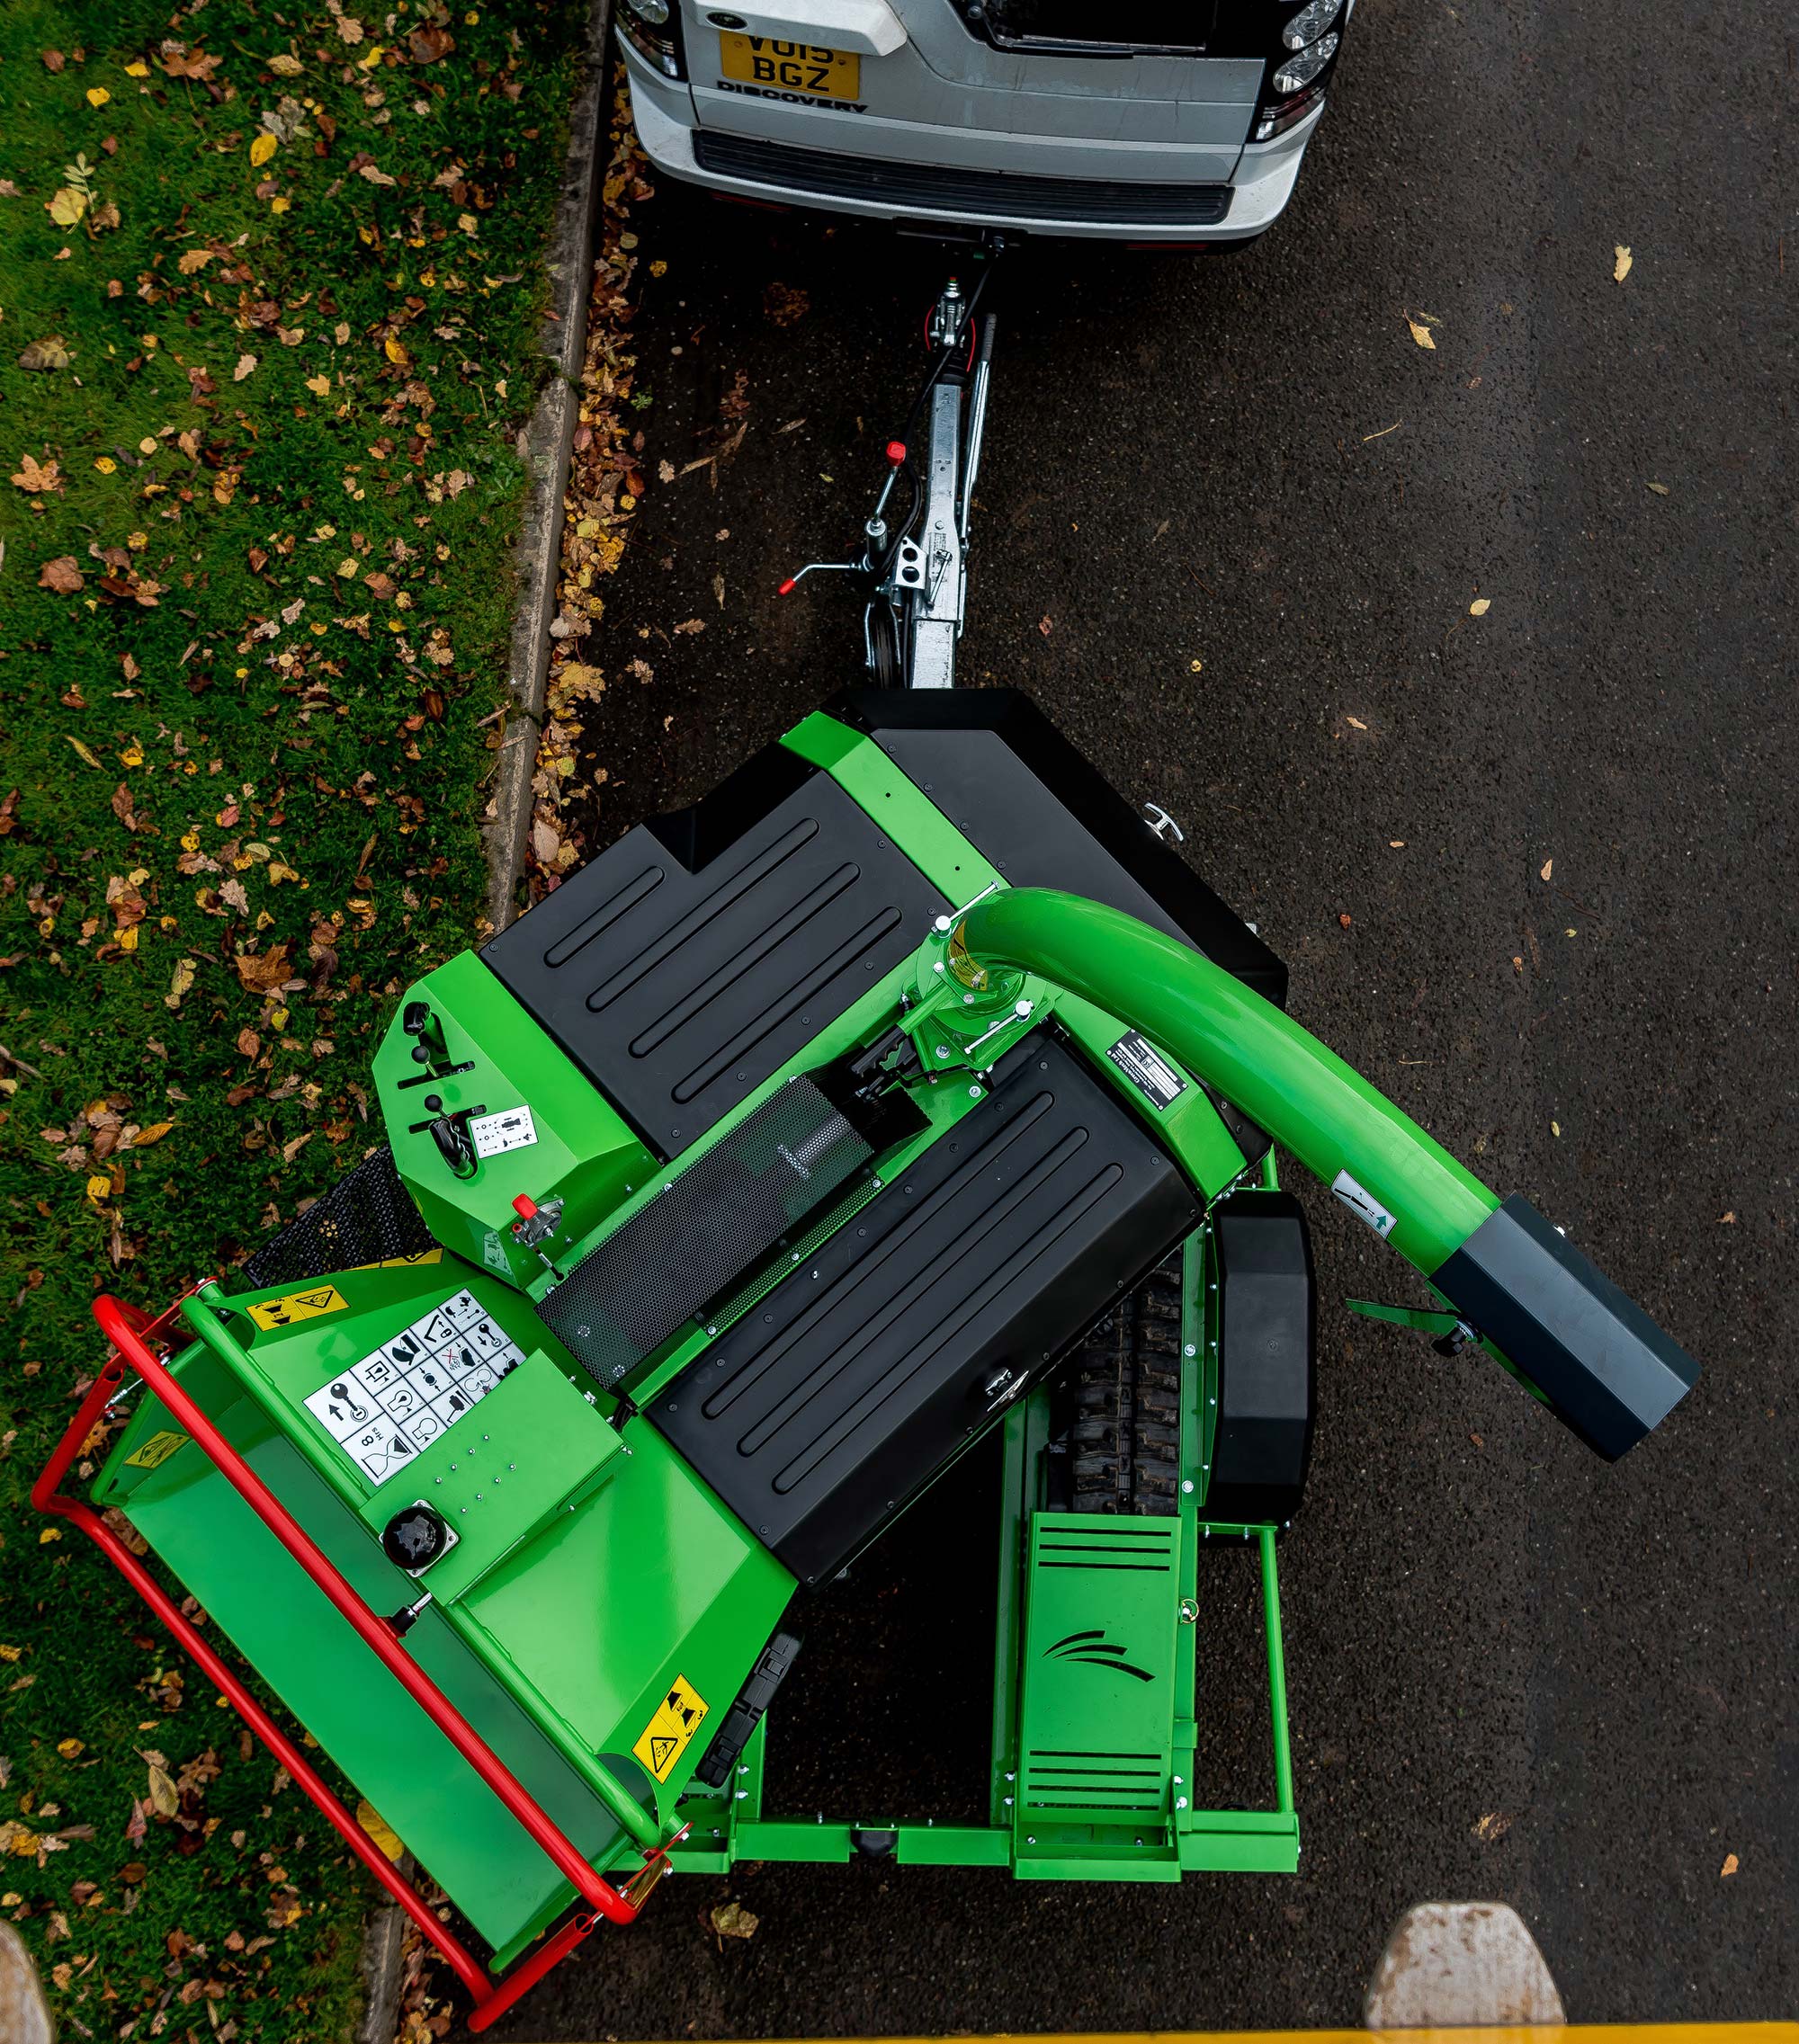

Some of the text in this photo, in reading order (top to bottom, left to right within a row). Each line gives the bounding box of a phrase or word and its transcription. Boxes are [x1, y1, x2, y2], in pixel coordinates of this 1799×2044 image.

[752, 56, 830, 93] BGZ
[716, 80, 869, 113] DISCOVERY
[361, 1434, 374, 1447] 8
[371, 1426, 384, 1442] Hrs
